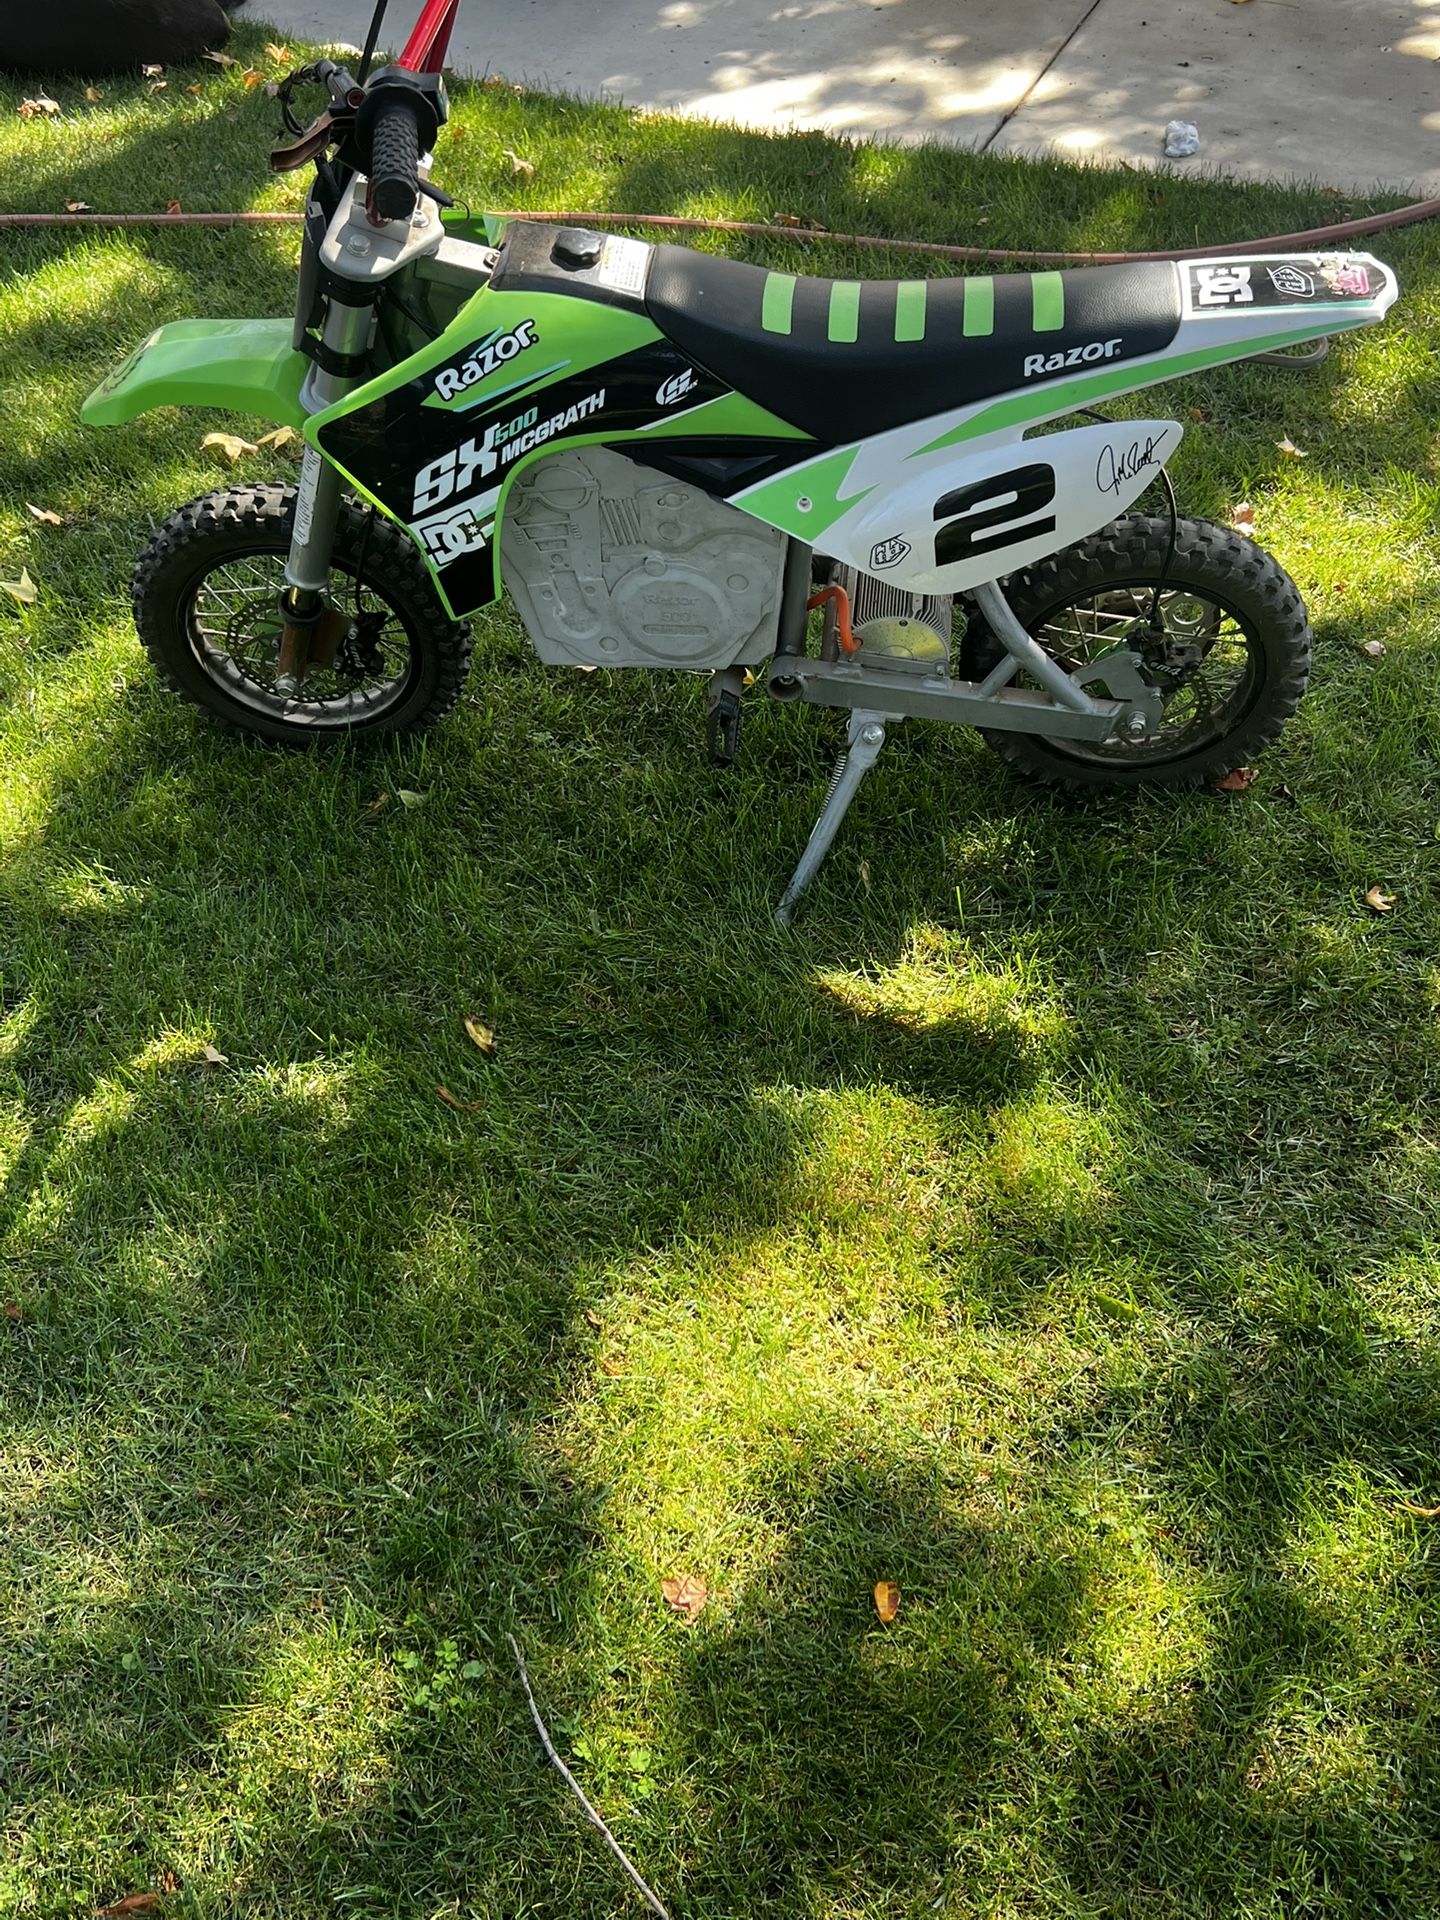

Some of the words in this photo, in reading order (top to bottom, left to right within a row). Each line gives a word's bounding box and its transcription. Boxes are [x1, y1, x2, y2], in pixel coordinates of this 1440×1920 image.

[434, 319, 536, 401] Razor
[1024, 338, 1121, 377] Razor
[412, 422, 501, 516] SX
[494, 406, 538, 446] 500
[501, 388, 606, 464] MCGRATH
[421, 509, 486, 565] DC
[933, 463, 1056, 567] 2
